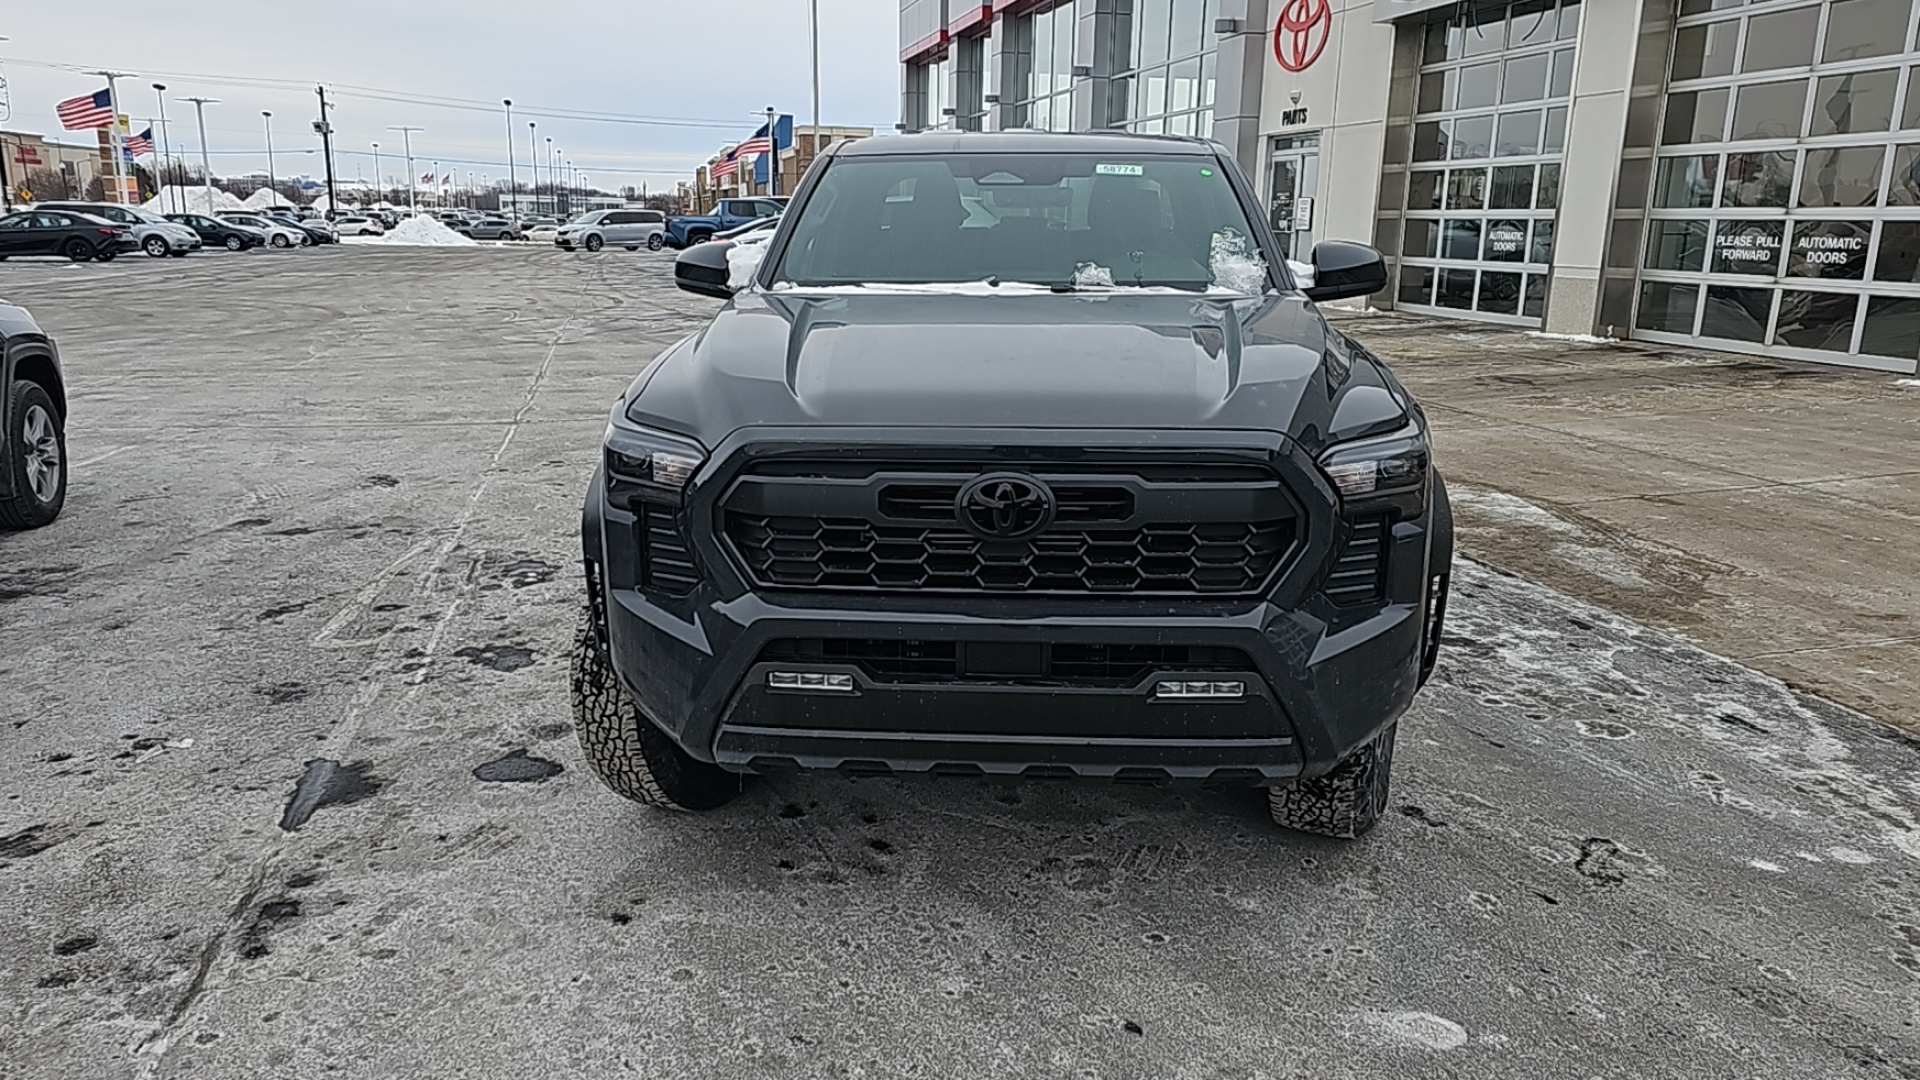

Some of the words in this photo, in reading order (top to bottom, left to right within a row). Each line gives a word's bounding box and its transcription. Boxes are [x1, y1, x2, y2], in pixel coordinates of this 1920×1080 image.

[1281, 107, 1308, 126] PARTS
[1488, 230, 1524, 241] AUTOMATIC
[1716, 234, 1754, 248] PLEASE
[1755, 235, 1781, 248] PULL
[1493, 241, 1517, 252] DOORS
[1797, 236, 1862, 250] AUTOMATIC
[1722, 248, 1771, 261] FORWARD
[1806, 251, 1848, 265] DOORS
